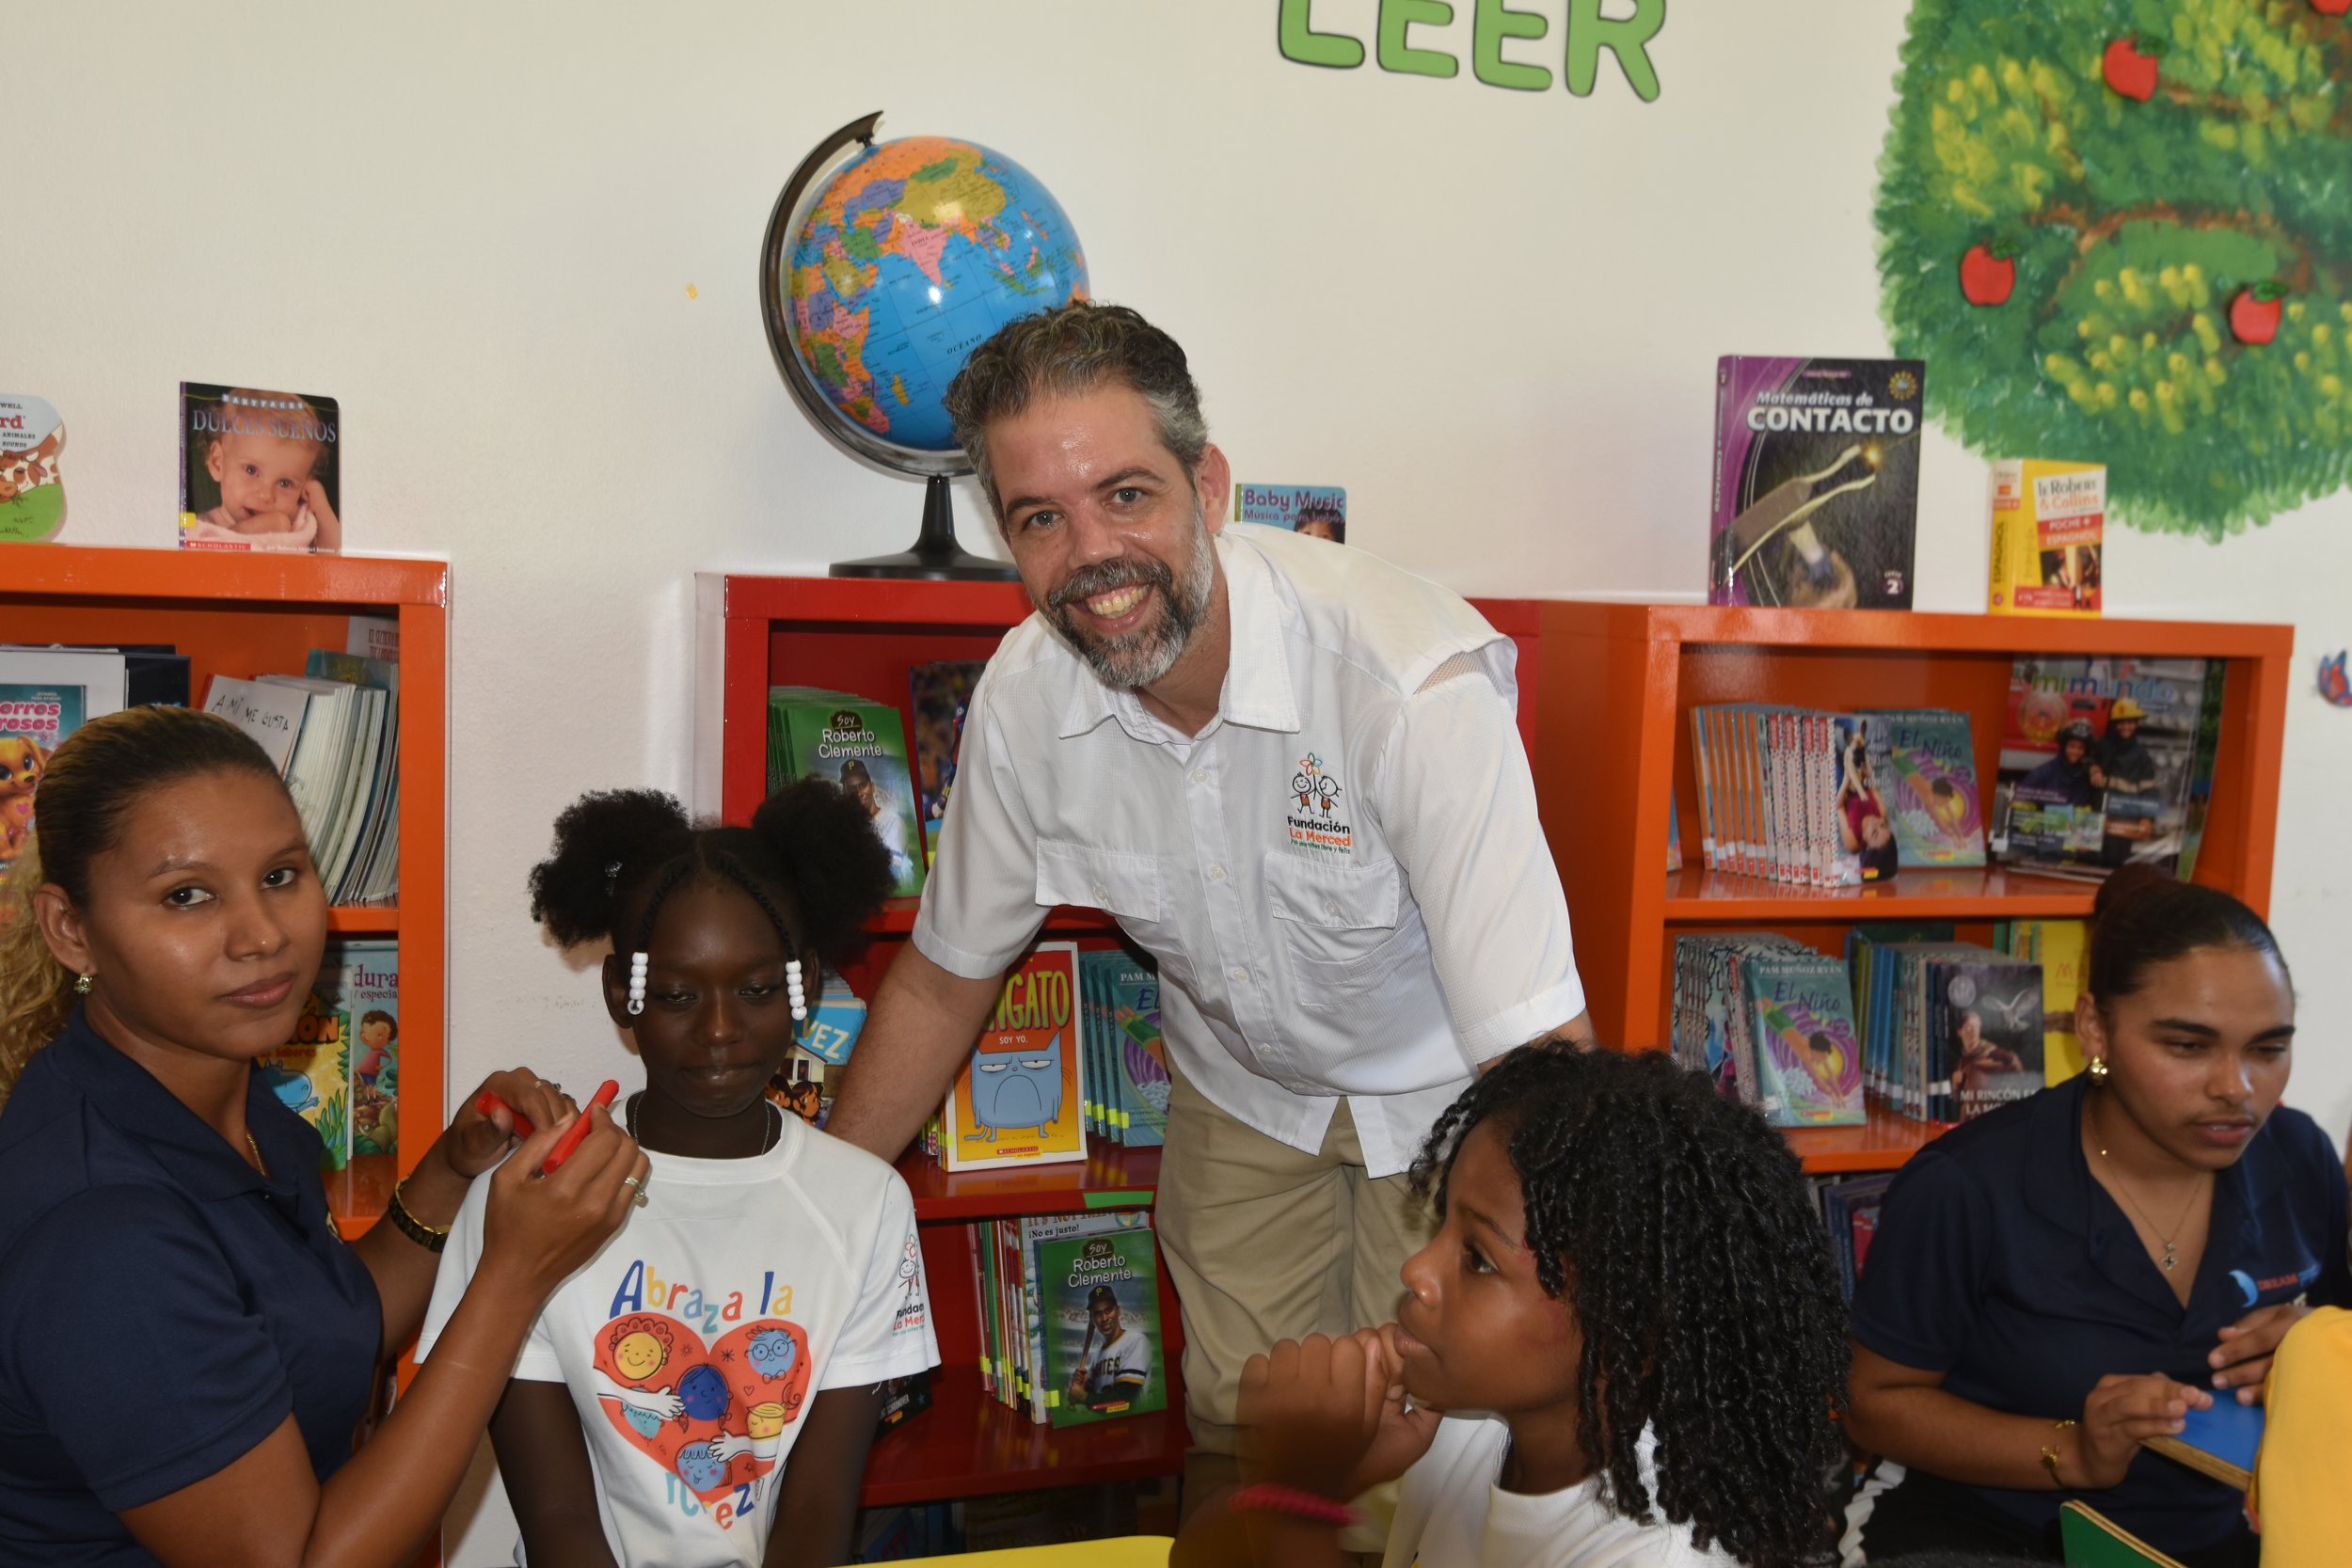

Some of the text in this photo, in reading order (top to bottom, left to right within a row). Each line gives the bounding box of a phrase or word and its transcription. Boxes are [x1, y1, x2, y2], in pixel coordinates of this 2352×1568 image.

[1278, 0, 1666, 103] LEER
[1756, 390, 1873, 406] Matemáticas de
[193, 410, 264, 436] DULCES
[1747, 406, 1915, 435] CONTACTO
[1245, 488, 1344, 513] Baby Music
[2053, 494, 2099, 510] Collins
[1283, 513, 1309, 524] para
[1887, 578, 1898, 594] 2
[2032, 673, 2174, 703] mi mundo
[212, 695, 226, 712] A
[241, 707, 259, 723] ME
[262, 712, 289, 733] GUSTA
[822, 729, 875, 743] Roberto
[1899, 729, 1919, 748] El
[818, 742, 882, 758] Clemente
[1287, 816, 1350, 834] Fundación
[1289, 827, 1351, 847] La Merced
[355, 963, 399, 989] dura
[1120, 973, 1144, 982] PAM
[1774, 980, 1796, 1002] El
[1797, 990, 1841, 1012] Niño
[999, 1036, 1013, 1045] SOY
[1961, 1089, 1975, 1101] MI
[1977, 1086, 2020, 1101] RINCÓN
[1966, 1102, 1980, 1116] LA
[1055, 1224, 1079, 1238] justo!
[1073, 1255, 1126, 1273] Roberto
[1068, 1268, 1132, 1288] Clemente
[609, 1259, 793, 1334] Abraza la
